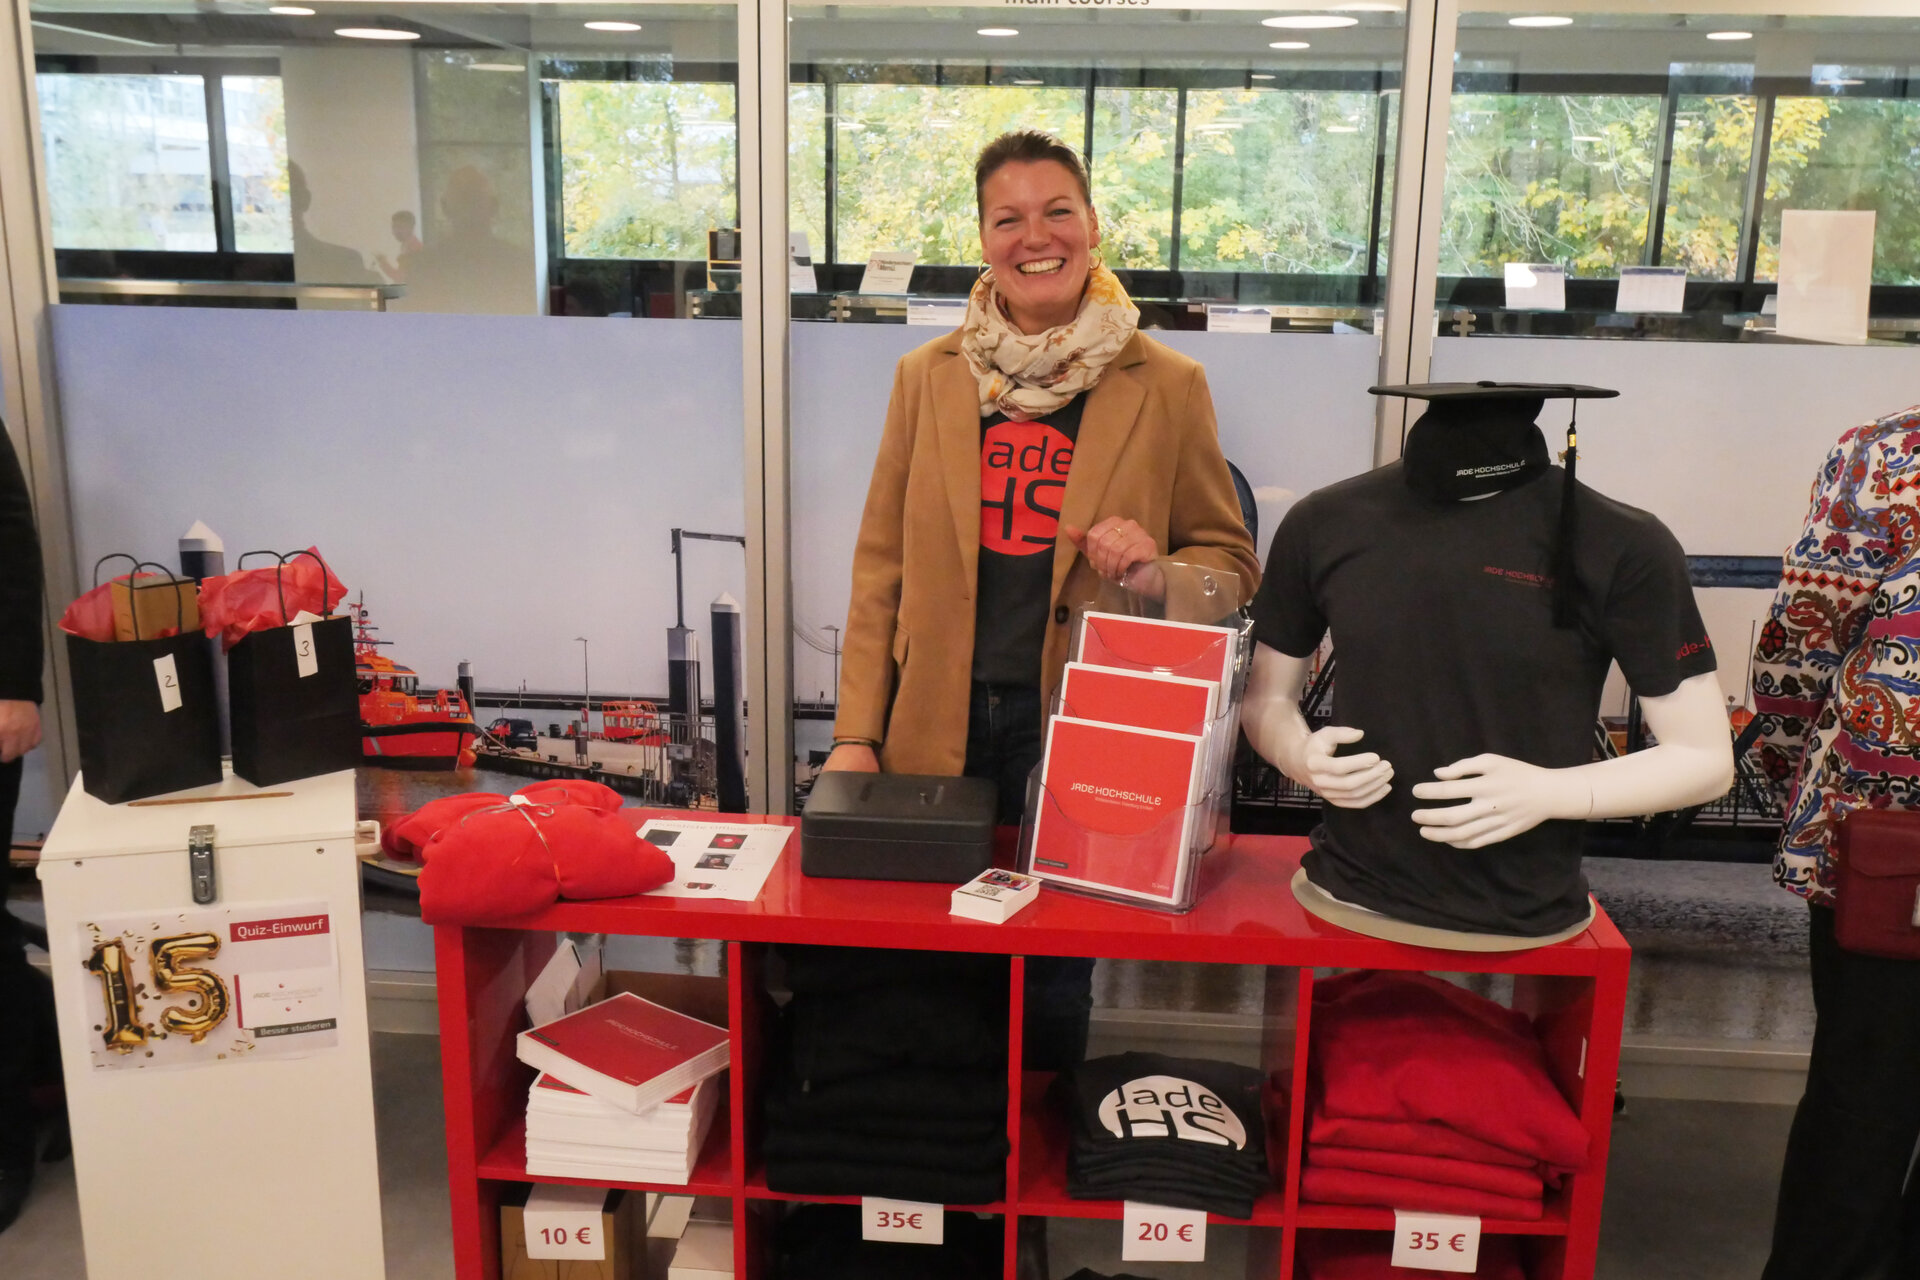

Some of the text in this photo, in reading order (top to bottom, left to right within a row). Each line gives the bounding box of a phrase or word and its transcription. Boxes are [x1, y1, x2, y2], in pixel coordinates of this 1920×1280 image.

[1456, 467, 1474, 477] JADE
[1474, 459, 1526, 474] HOCHSCHULE
[981, 477, 1067, 545] HS
[299, 640, 310, 657] 3
[165, 675, 177, 688] 2
[1070, 782, 1095, 795] JADE
[1095, 787, 1162, 806] HOCHSCHULE
[237, 919, 325, 938] Quiz-Einwurf
[260, 1021, 332, 1036] Besser studieren
[1115, 1086, 1225, 1116] Jade
[1116, 1108, 1238, 1150] HS
[876, 1211, 923, 1230] 35€
[540, 1227, 591, 1245] 10 €
[1138, 1223, 1194, 1242] 20 €
[1409, 1231, 1466, 1252] 35 €
